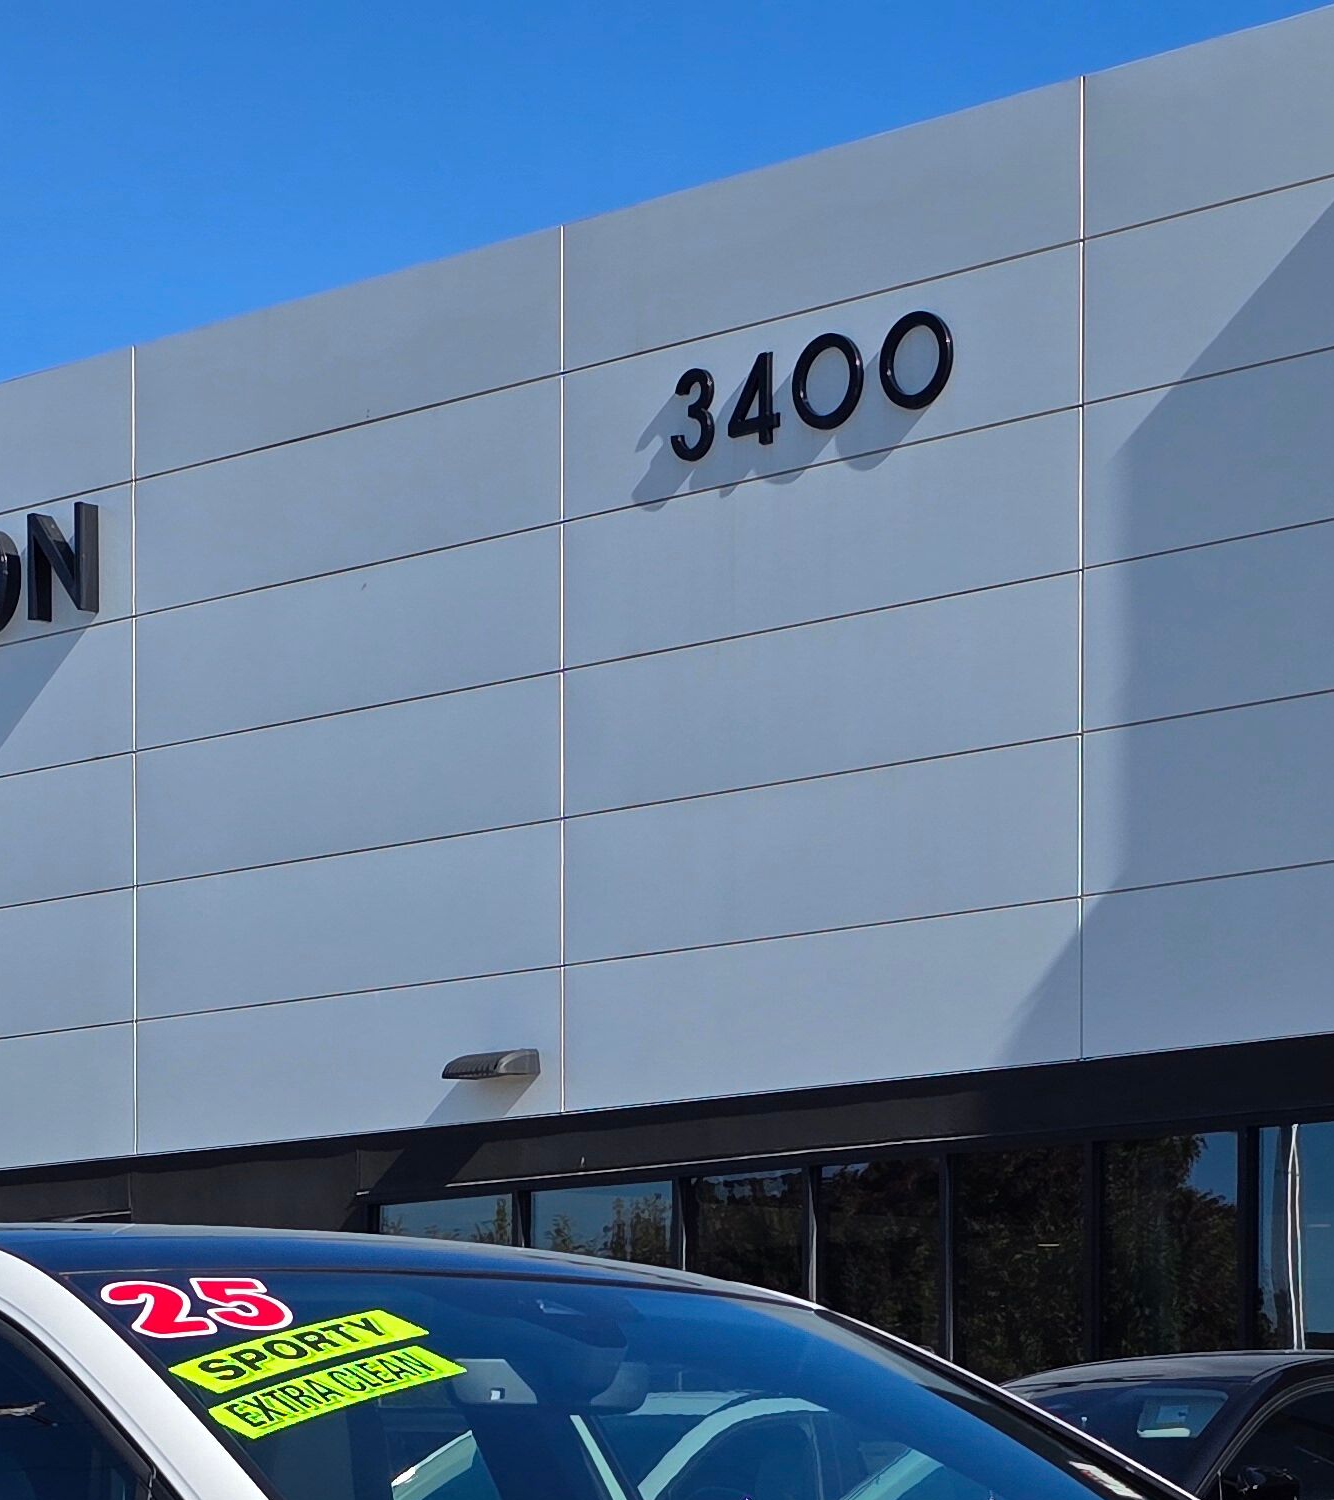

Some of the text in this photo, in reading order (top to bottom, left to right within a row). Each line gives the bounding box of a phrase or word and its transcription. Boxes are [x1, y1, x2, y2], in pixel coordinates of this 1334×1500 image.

[671, 310, 954, 462] 3400
[100, 1277, 293, 1339] 25
[197, 1317, 389, 1381] SPORTY
[224, 1349, 434, 1428] EXTRA CLEAN
